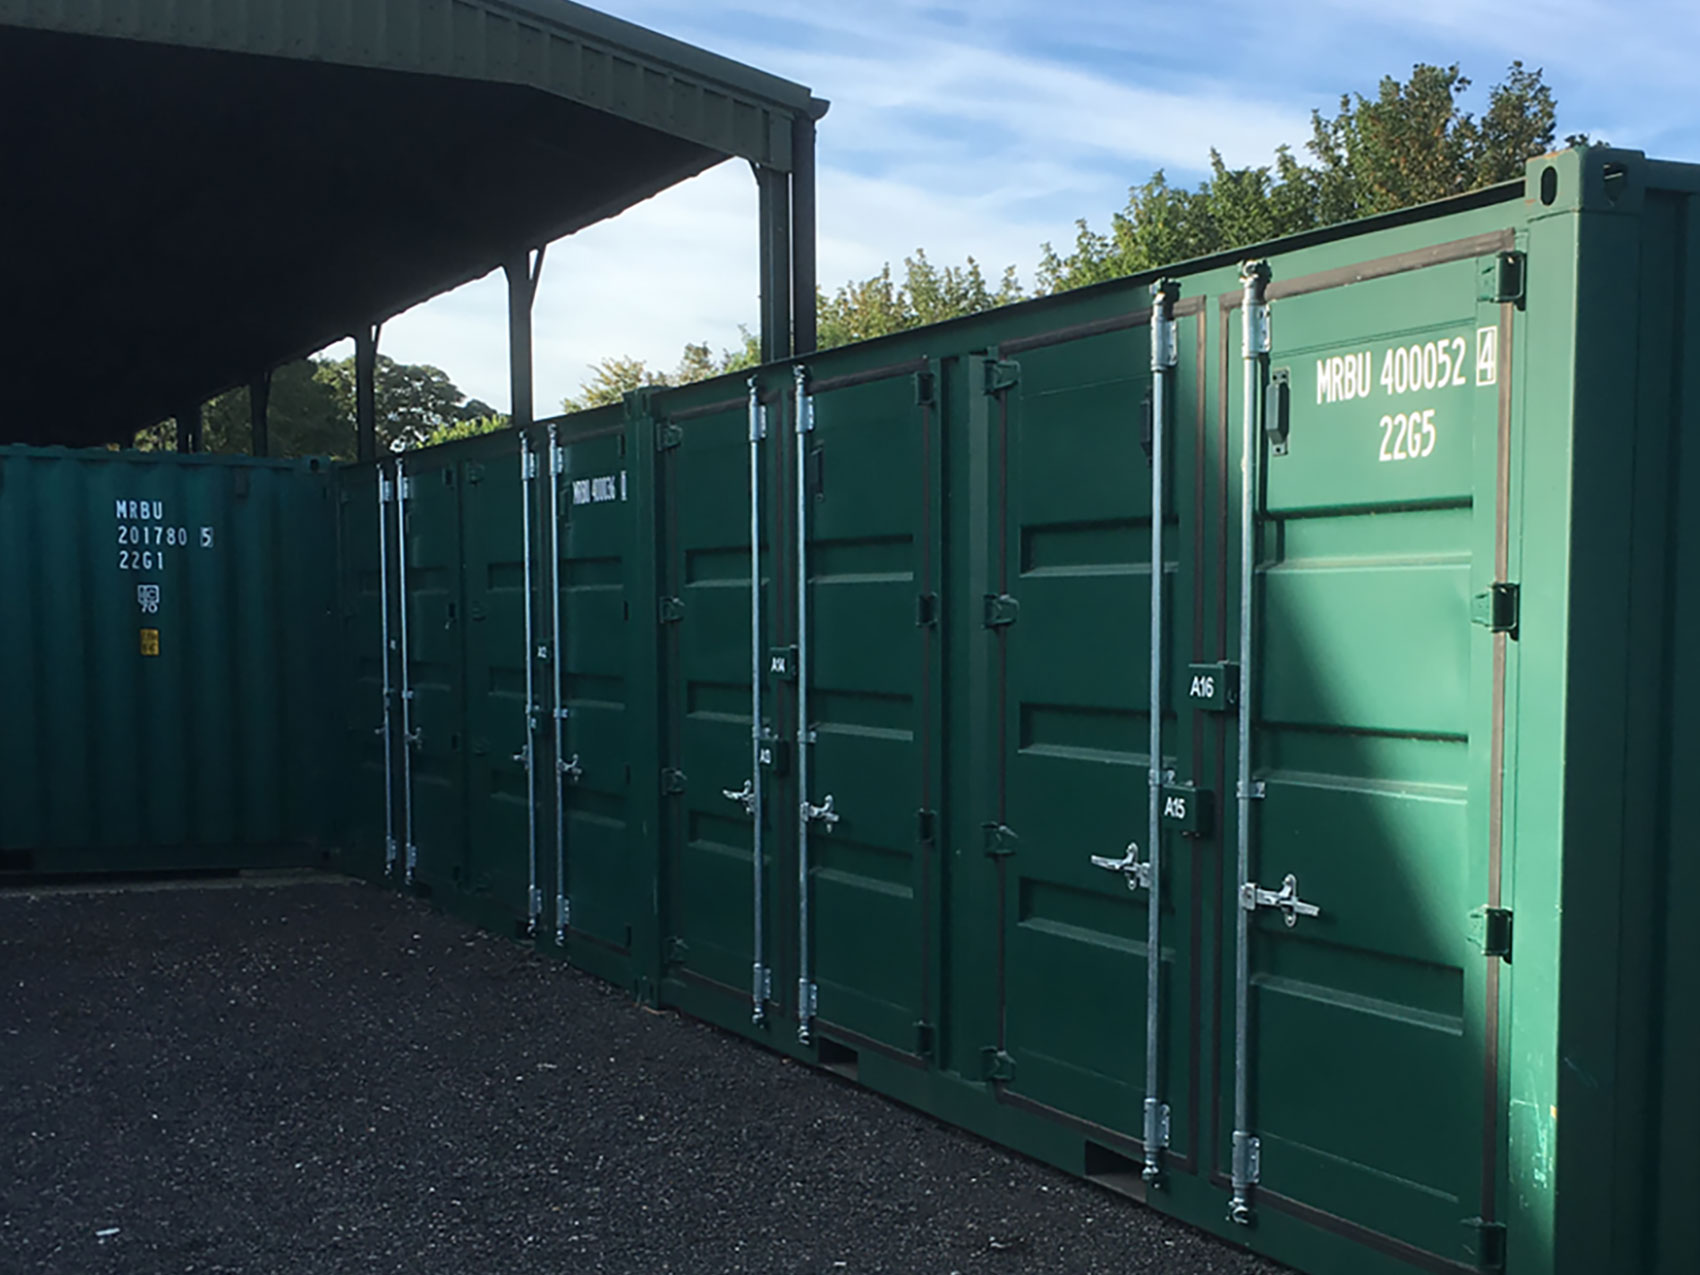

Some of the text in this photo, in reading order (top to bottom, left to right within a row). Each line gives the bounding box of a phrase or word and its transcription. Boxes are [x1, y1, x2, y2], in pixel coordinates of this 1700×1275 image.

[1316, 328, 1496, 405] MRBU 400052 4
[1379, 409, 1436, 461] 22G5
[116, 500, 163, 520] MRBU
[118, 526, 213, 547] 201780 5
[119, 551, 164, 570] 22G1
[1190, 676, 1214, 698] A16
[1164, 797, 1186, 819] A15
